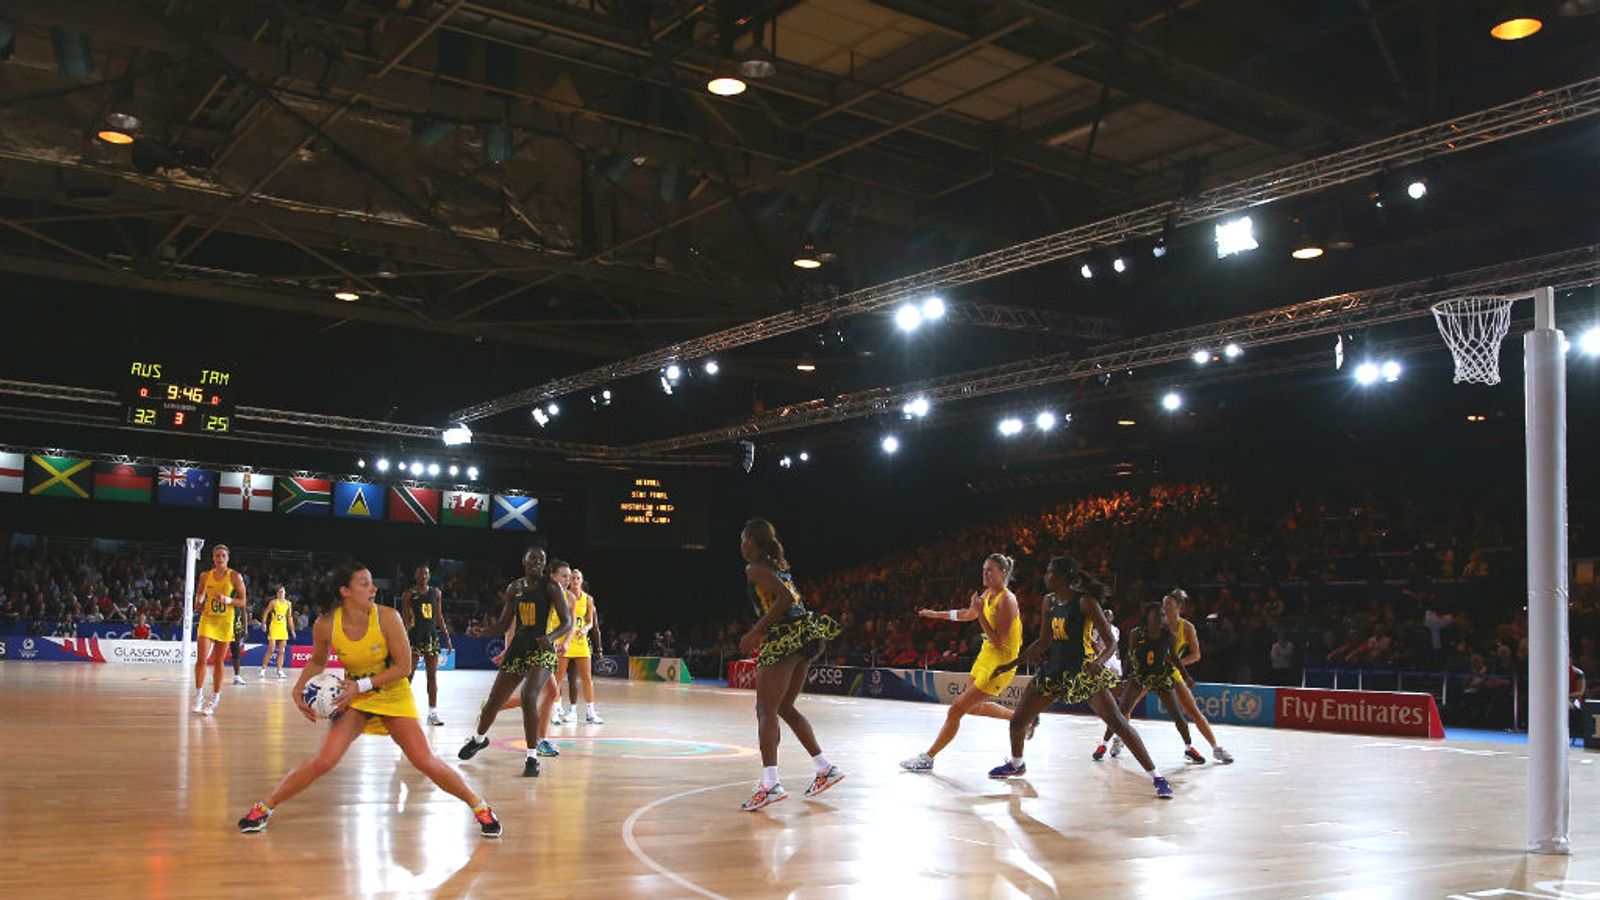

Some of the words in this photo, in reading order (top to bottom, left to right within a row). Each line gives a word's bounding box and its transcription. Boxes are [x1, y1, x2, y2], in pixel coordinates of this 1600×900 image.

[131, 362, 161, 378] AUS
[200, 370, 229, 385] JAM
[168, 385, 203, 403] 9:46
[134, 408, 156, 424] 32
[174, 412, 184, 425] 3
[207, 416, 228, 431] 25
[114, 647, 171, 658] GLASGOW
[175, 649, 197, 658] 24
[819, 667, 842, 685] sse
[1157, 690, 1230, 717] ucef
[1282, 696, 1316, 723] Fly
[1322, 698, 1424, 725] Emirates
